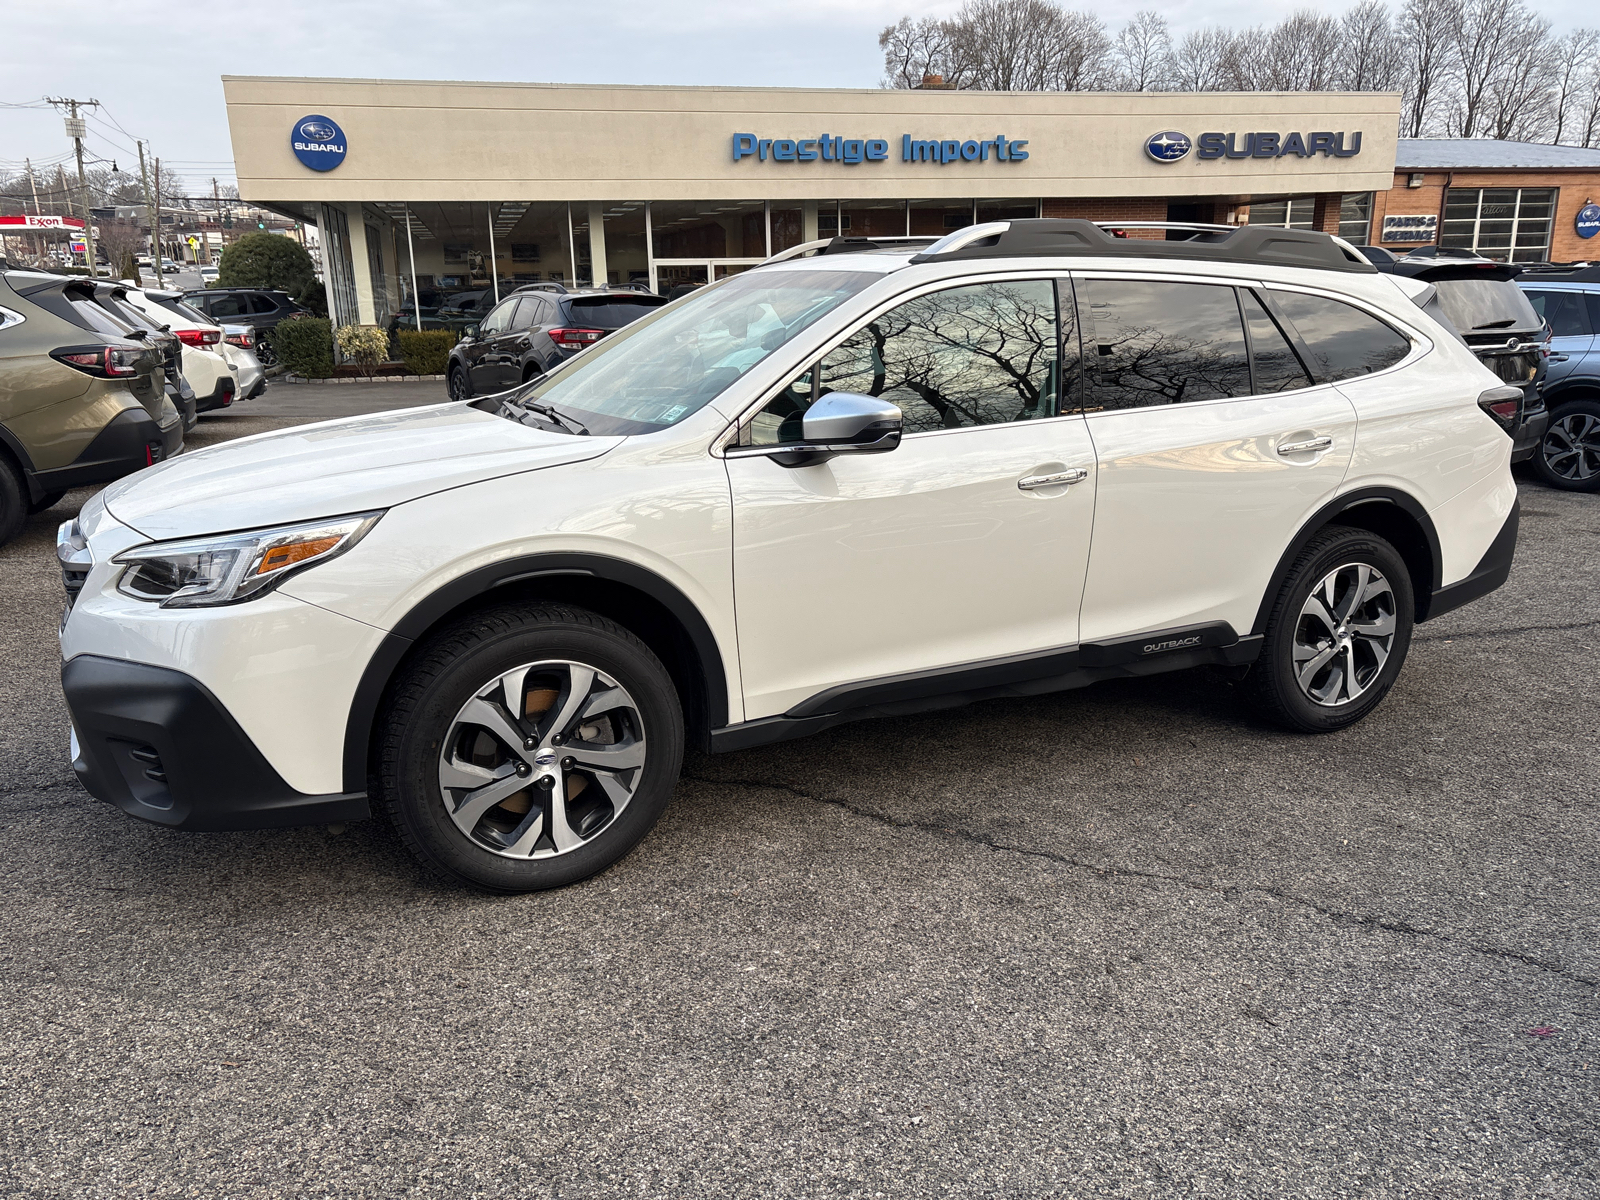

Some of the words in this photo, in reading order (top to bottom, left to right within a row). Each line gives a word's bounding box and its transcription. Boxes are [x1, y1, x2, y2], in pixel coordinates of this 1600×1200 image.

[294, 142, 343, 153] SUBARU
[732, 132, 889, 164] Prestige
[902, 134, 1029, 164] Imports
[1197, 131, 1362, 158] SUBARU
[29, 217, 59, 228] Exxon
[1385, 216, 1427, 227] PARTS
[1383, 230, 1437, 241] SERVICE
[1143, 636, 1201, 653] OUTBACK
